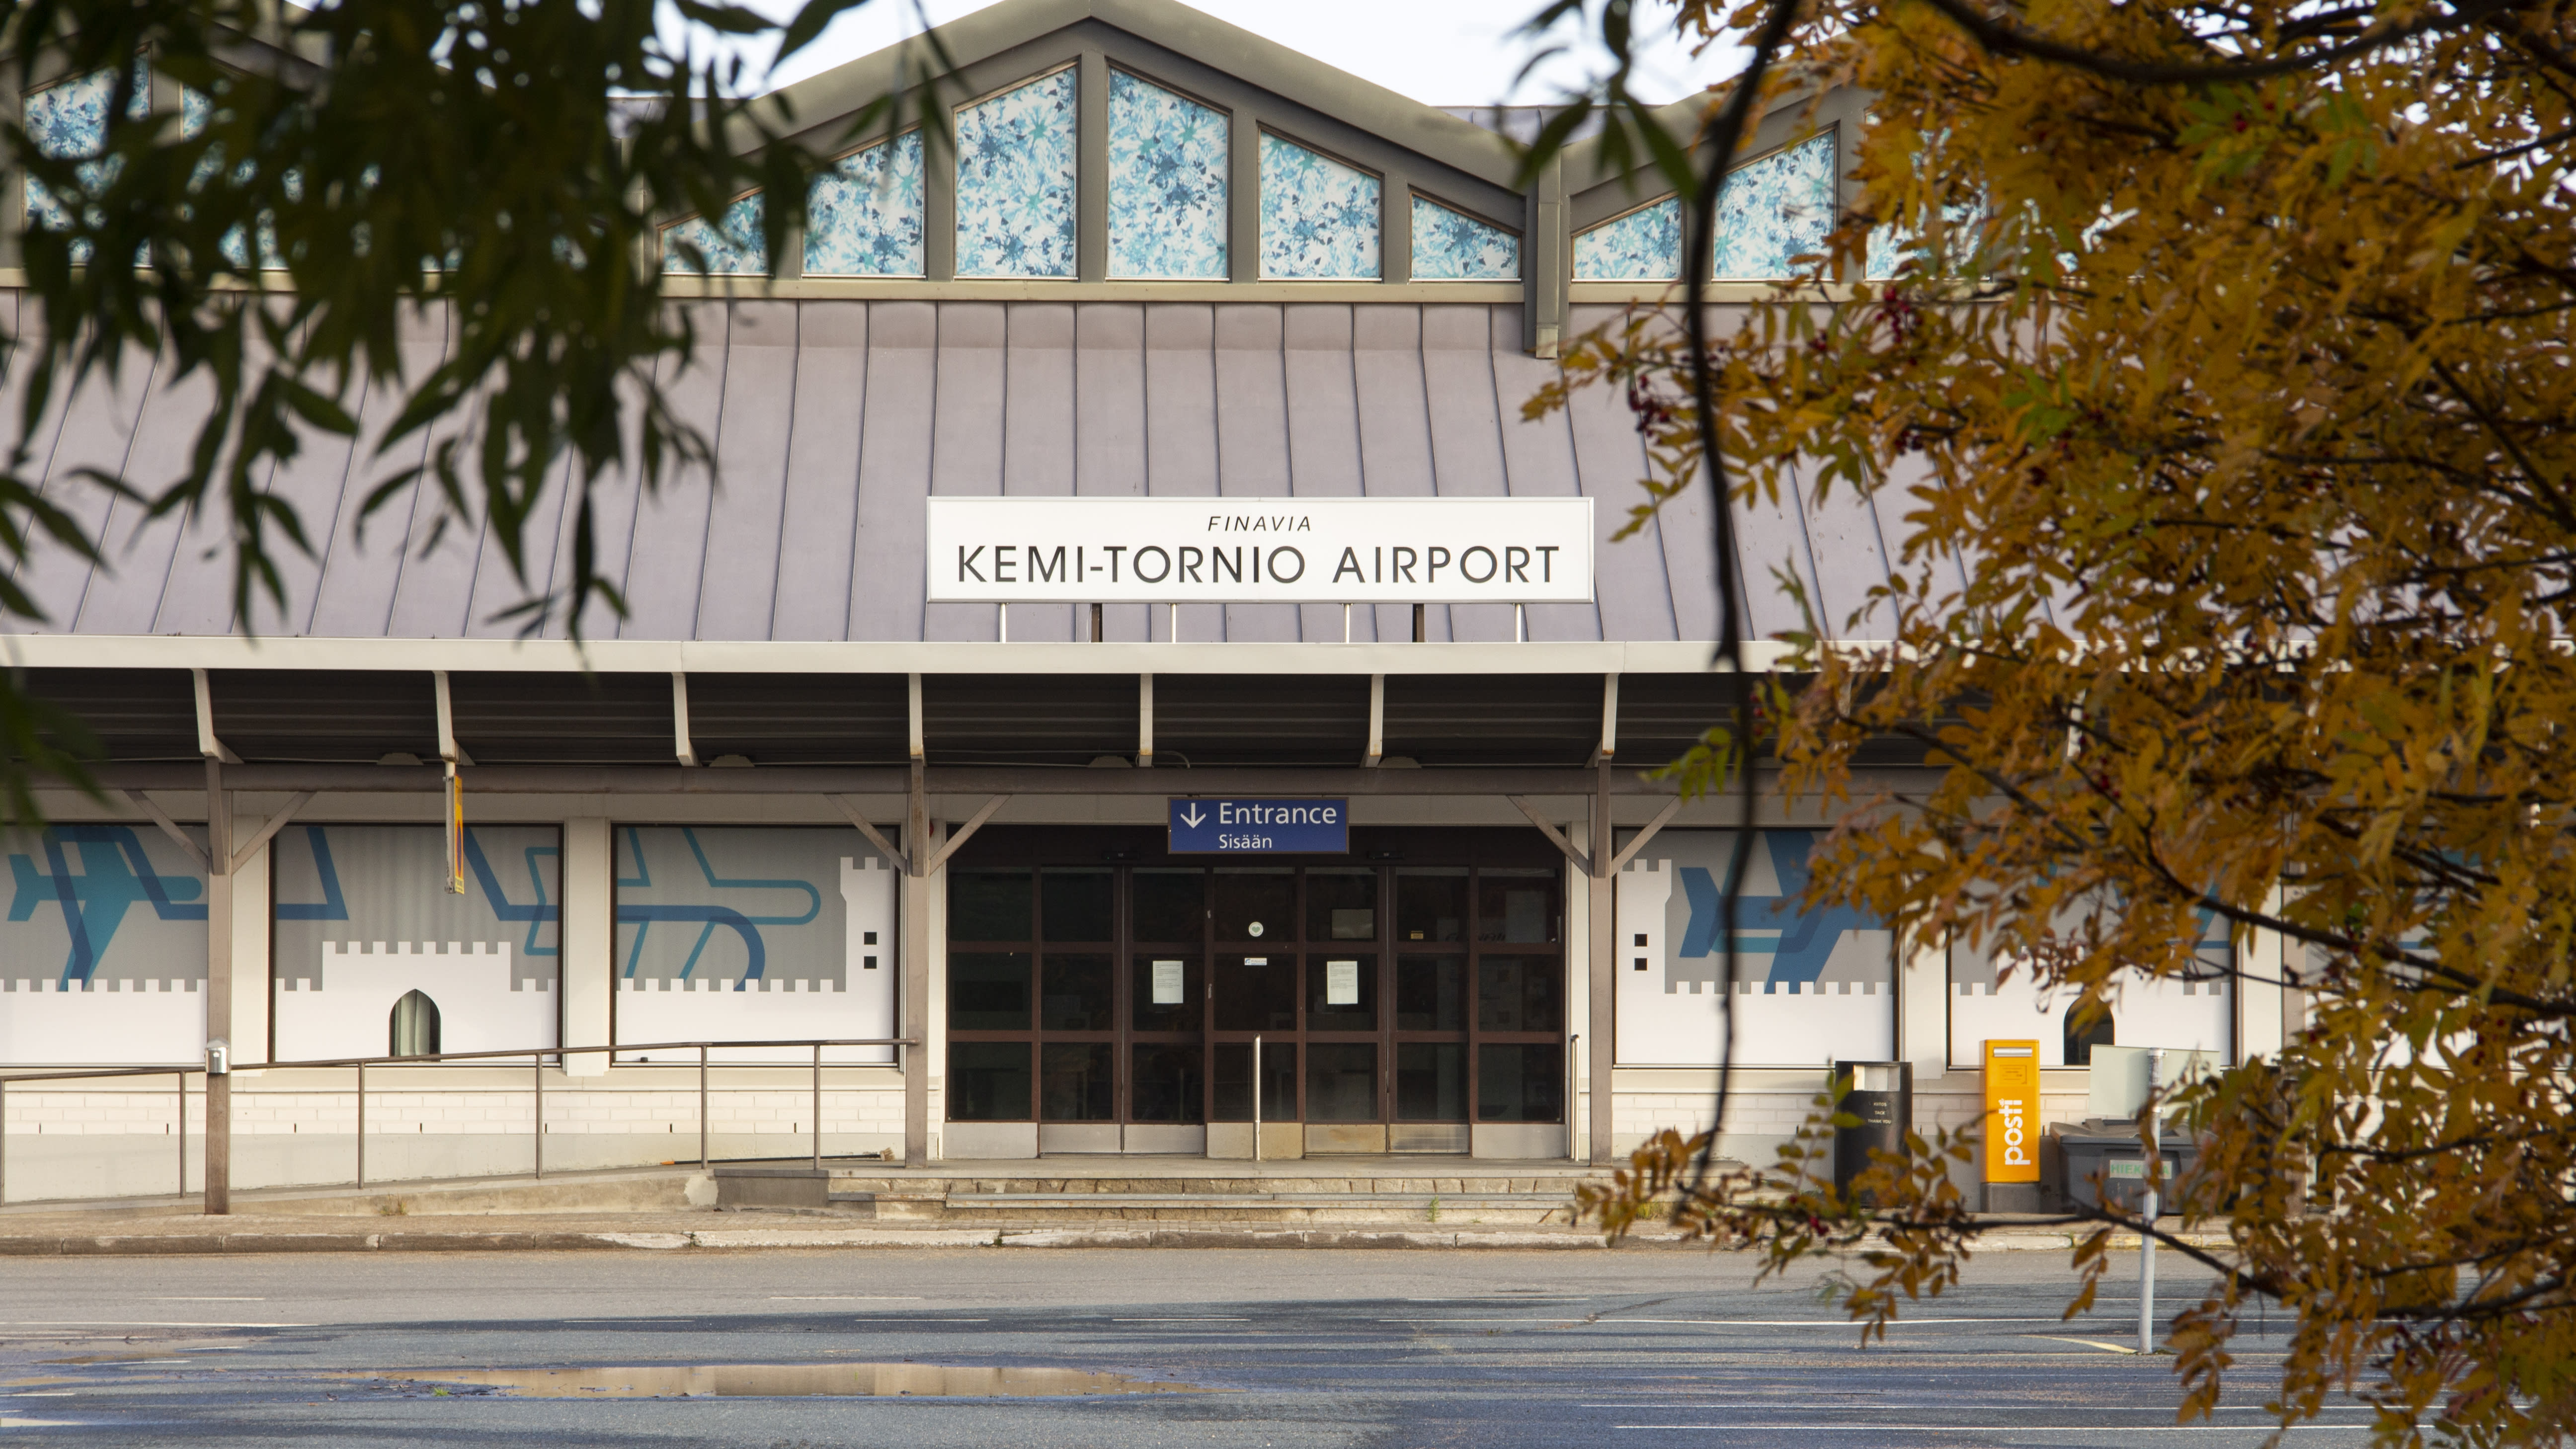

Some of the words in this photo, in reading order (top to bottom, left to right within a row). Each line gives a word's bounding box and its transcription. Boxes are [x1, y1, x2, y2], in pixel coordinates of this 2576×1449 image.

[1208, 516, 1311, 532] FINAVIA
[958, 545, 1305, 584] KEMI-TORNIO
[1332, 546, 1560, 583] AIRPORT
[1219, 803, 1337, 824] Entrance
[1219, 833, 1272, 849] Sisään
[1998, 1098, 2031, 1165] posti
[2110, 1164, 2170, 1174] HIEKA
